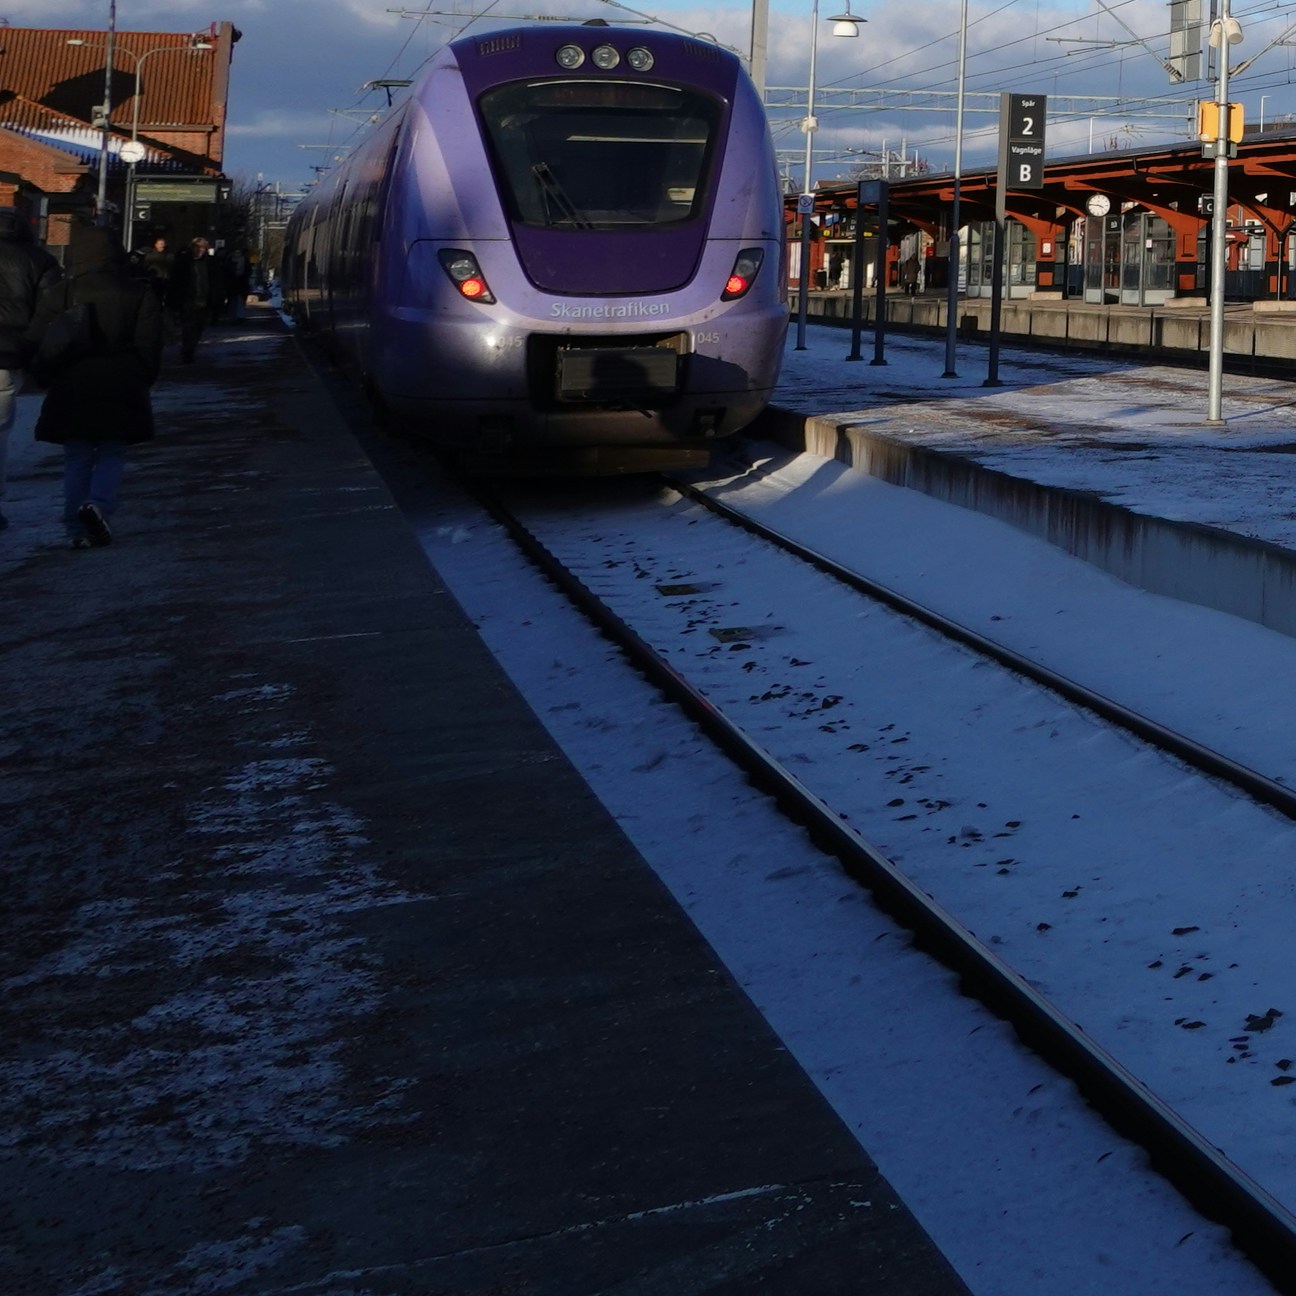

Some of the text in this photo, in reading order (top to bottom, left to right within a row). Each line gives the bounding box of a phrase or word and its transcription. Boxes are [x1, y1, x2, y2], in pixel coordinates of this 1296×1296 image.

[1022, 117, 1034, 135] 2
[1011, 146, 1042, 155] Vagnläge
[1019, 164, 1032, 182] B
[138, 211, 146, 219] C
[697, 331, 720, 344] 045
